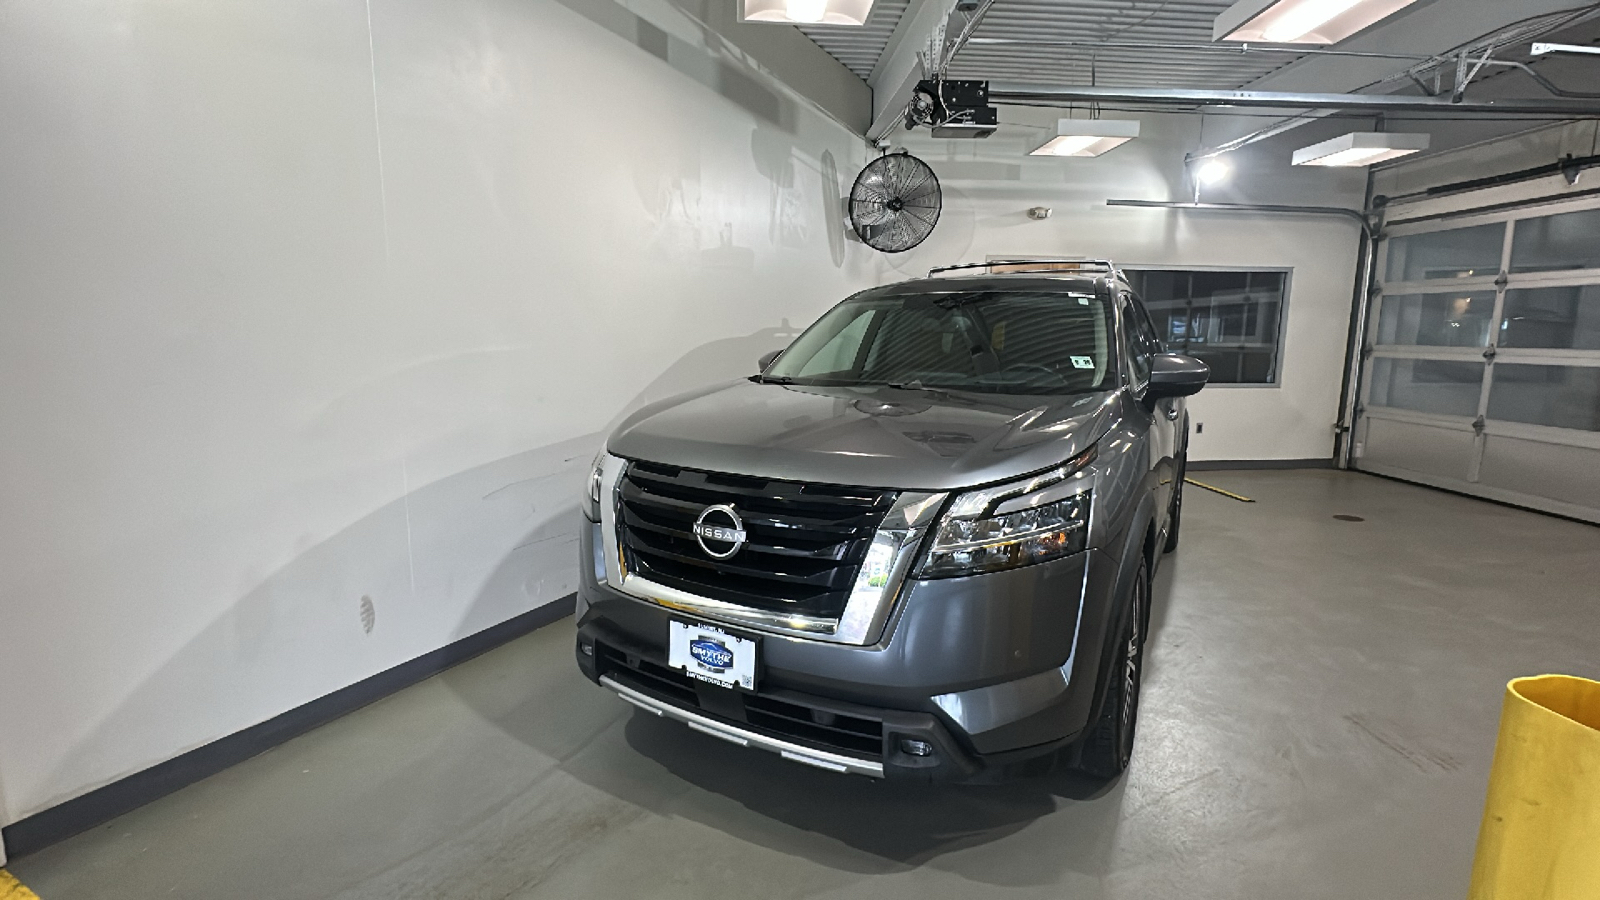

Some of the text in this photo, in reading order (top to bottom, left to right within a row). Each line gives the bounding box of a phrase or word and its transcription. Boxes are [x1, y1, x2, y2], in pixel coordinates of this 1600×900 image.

[693, 524, 745, 542] NISSAN
[692, 646, 731, 663] SMYTHE
[700, 654, 724, 666] VOLVO
